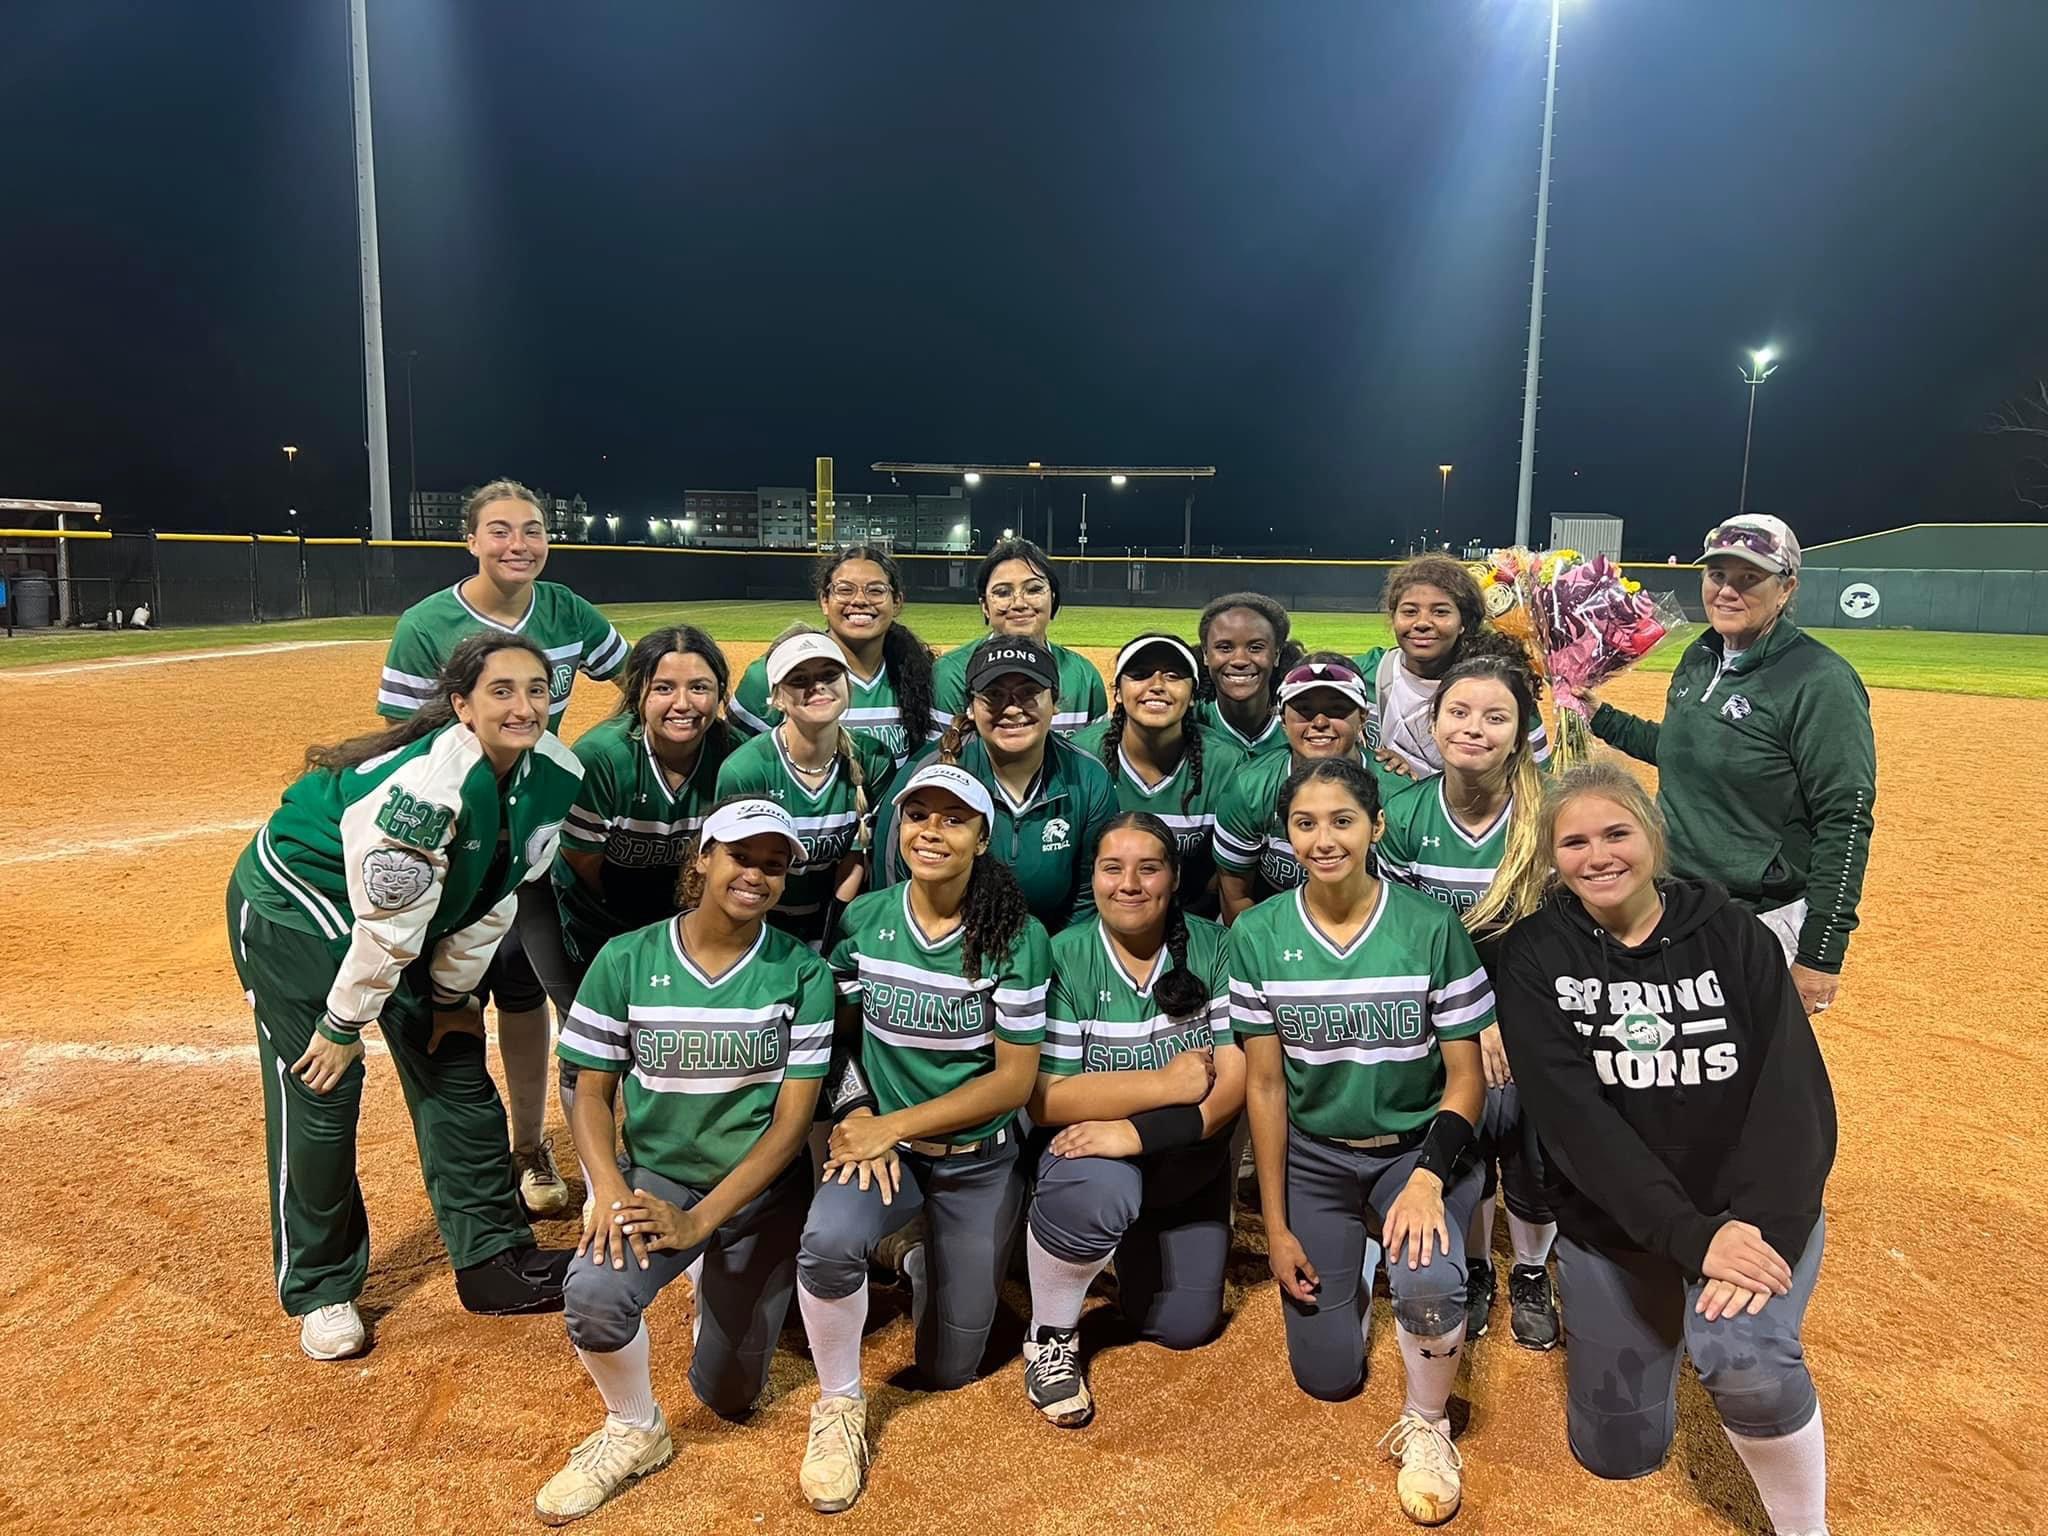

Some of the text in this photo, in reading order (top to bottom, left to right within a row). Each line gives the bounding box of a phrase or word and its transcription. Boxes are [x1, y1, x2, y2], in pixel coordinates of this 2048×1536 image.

[987, 649, 1037, 664] LIONS
[608, 832, 691, 865] SPRI
[860, 977, 983, 1033] SPRING
[1555, 970, 1726, 1015] SPRING
[1276, 1000, 1421, 1043] SPRING
[636, 1026, 780, 1070] SPRING
[1592, 1042, 1739, 1089] IONS
